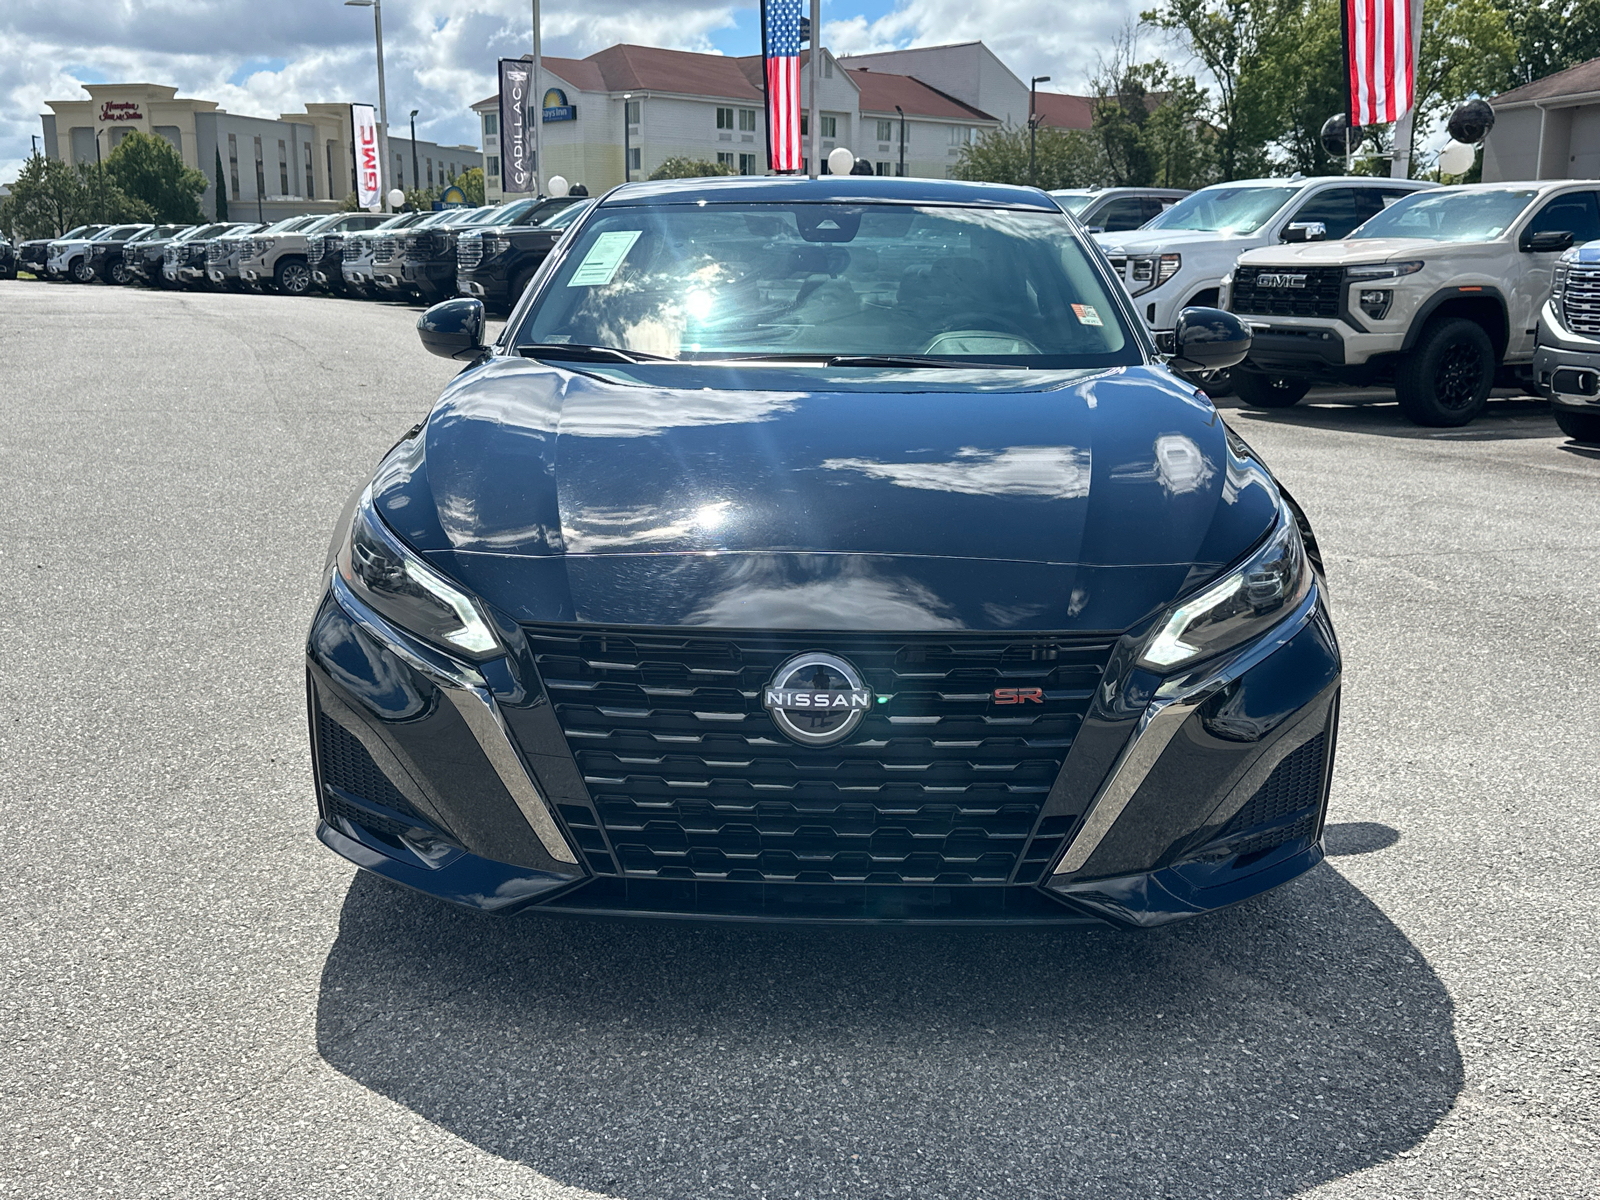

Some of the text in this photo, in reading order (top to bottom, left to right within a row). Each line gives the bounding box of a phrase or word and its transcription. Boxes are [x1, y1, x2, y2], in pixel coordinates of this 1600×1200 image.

[556, 108, 567, 116] Inn
[512, 87, 525, 185] CADILLAC
[360, 125, 378, 191] GMC
[1256, 273, 1308, 289] GMC
[767, 691, 868, 707] NISSAN
[994, 687, 1043, 705] SR
